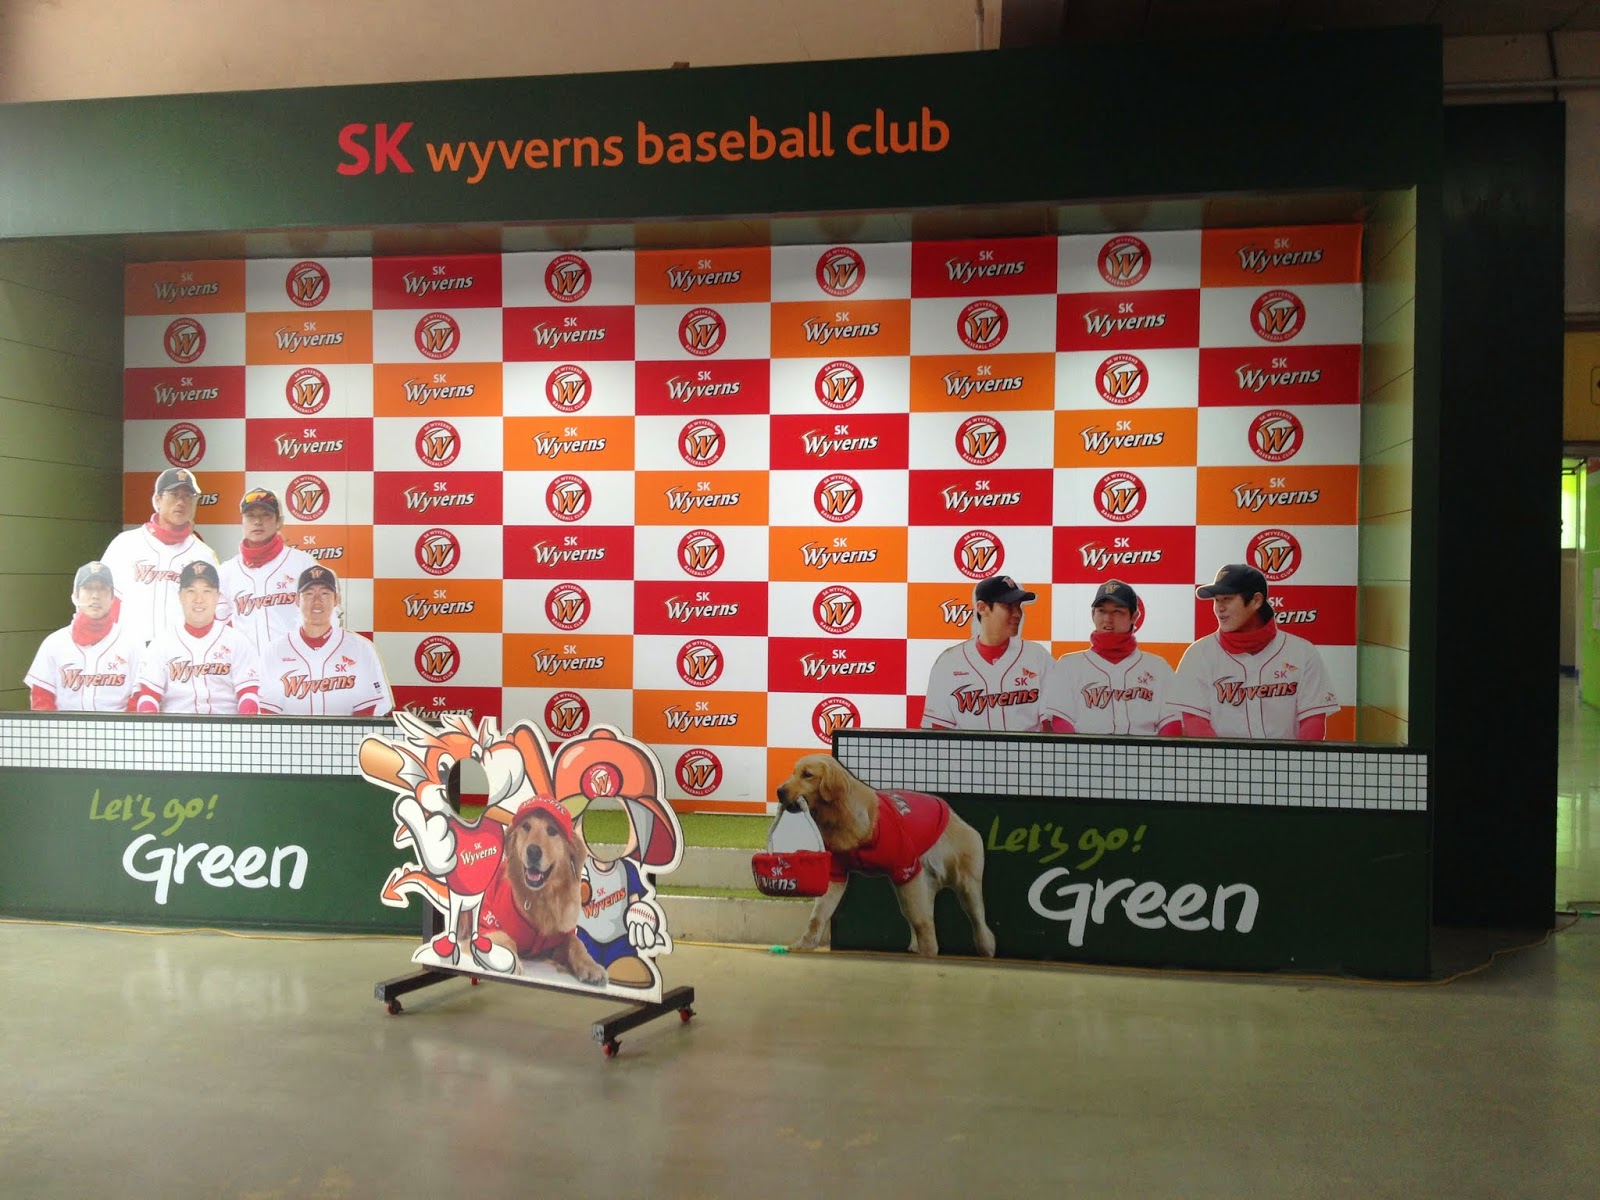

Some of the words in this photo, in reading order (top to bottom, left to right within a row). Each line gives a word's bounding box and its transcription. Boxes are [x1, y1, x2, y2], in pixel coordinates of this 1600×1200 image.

[336, 121, 414, 174] SK
[426, 134, 623, 184] wyverns
[637, 111, 834, 166] baseball
[846, 106, 950, 157] club
[978, 250, 993, 261] SK
[1273, 238, 1289, 249] SK
[432, 265, 445, 275] SK
[698, 258, 711, 269] SK
[944, 254, 1024, 285] Wyverns
[1237, 242, 1322, 273] Wyverns
[180, 271, 192, 282] SK
[401, 269, 473, 298] Wyverns
[665, 263, 741, 292] Wyverns
[151, 276, 220, 304] Wyverns
[835, 311, 849, 322] SK
[1118, 302, 1133, 313] SK
[303, 321, 316, 331] SK
[563, 316, 577, 327] SK
[801, 316, 880, 345] Wyverns
[1083, 307, 1165, 337] Wyverns
[273, 325, 344, 353] Wyverns
[532, 321, 606, 349] Wyverns
[697, 370, 711, 380] SK
[977, 365, 991, 376] SK
[1271, 357, 1286, 369] SK
[180, 376, 192, 387] SK
[433, 373, 446, 383] SK
[665, 374, 741, 403] Wyverns
[942, 369, 1023, 399] Wyverns
[1234, 362, 1319, 392] Wyverns
[151, 381, 220, 408] Wyverns
[402, 377, 474, 405] Wyverns
[303, 428, 316, 438] SK
[564, 426, 577, 437] SK
[834, 424, 848, 435] SK
[1116, 420, 1131, 431] SK
[273, 432, 344, 459] Wyverns
[532, 431, 606, 459] Wyverns
[800, 429, 878, 457] Wyverns
[1080, 425, 1163, 454] Wyverns
[433, 481, 446, 491] SK
[697, 481, 710, 491] SK
[975, 480, 989, 491] SK
[1269, 477, 1284, 488] SK
[402, 486, 474, 513] Wyverns
[664, 486, 740, 513] Wyverns
[941, 485, 1021, 513] Wyverns
[1233, 482, 1317, 511] Wyverns
[303, 536, 316, 545] SK
[563, 536, 577, 546] SK
[833, 537, 846, 547] SK
[1114, 537, 1128, 548] SK
[532, 541, 606, 568] Wyverns
[799, 542, 877, 569] Wyverns
[1078, 542, 1160, 571] Wyverns
[234, 590, 297, 616] Wyverns
[402, 594, 474, 620] Wyverns
[433, 589, 446, 599] SK
[696, 591, 709, 601] SK
[1268, 597, 1284, 607] SK
[663, 596, 739, 623] Wyverns
[531, 649, 605, 676] Wyverns
[563, 644, 576, 655] SK
[832, 648, 846, 659] SK
[60, 663, 126, 691] Wyverns
[107, 662, 118, 670] SK
[167, 656, 231, 683] Wyverns
[335, 664, 347, 672] SK
[799, 653, 876, 681] Wyverns
[1274, 670, 1288, 679] SK
[281, 669, 356, 700] Wyverns
[1015, 677, 1028, 686] SK
[1213, 675, 1298, 706] Wyverns
[433, 697, 446, 706] SK
[695, 701, 708, 711] SK
[950, 684, 1039, 715] Wyverns
[1081, 681, 1153, 709] Wyverns
[663, 705, 738, 734] Wyverns
[89, 788, 156, 831] Let's
[161, 794, 219, 836] go!
[460, 846, 497, 866] Wyverns
[474, 842, 482, 850] SK
[987, 816, 1069, 864] Let's
[1076, 824, 1147, 871] go!
[122, 833, 308, 905] Green
[771, 867, 783, 876] SK
[582, 888, 626, 918] Wyverns
[1027, 867, 1260, 947] Green
